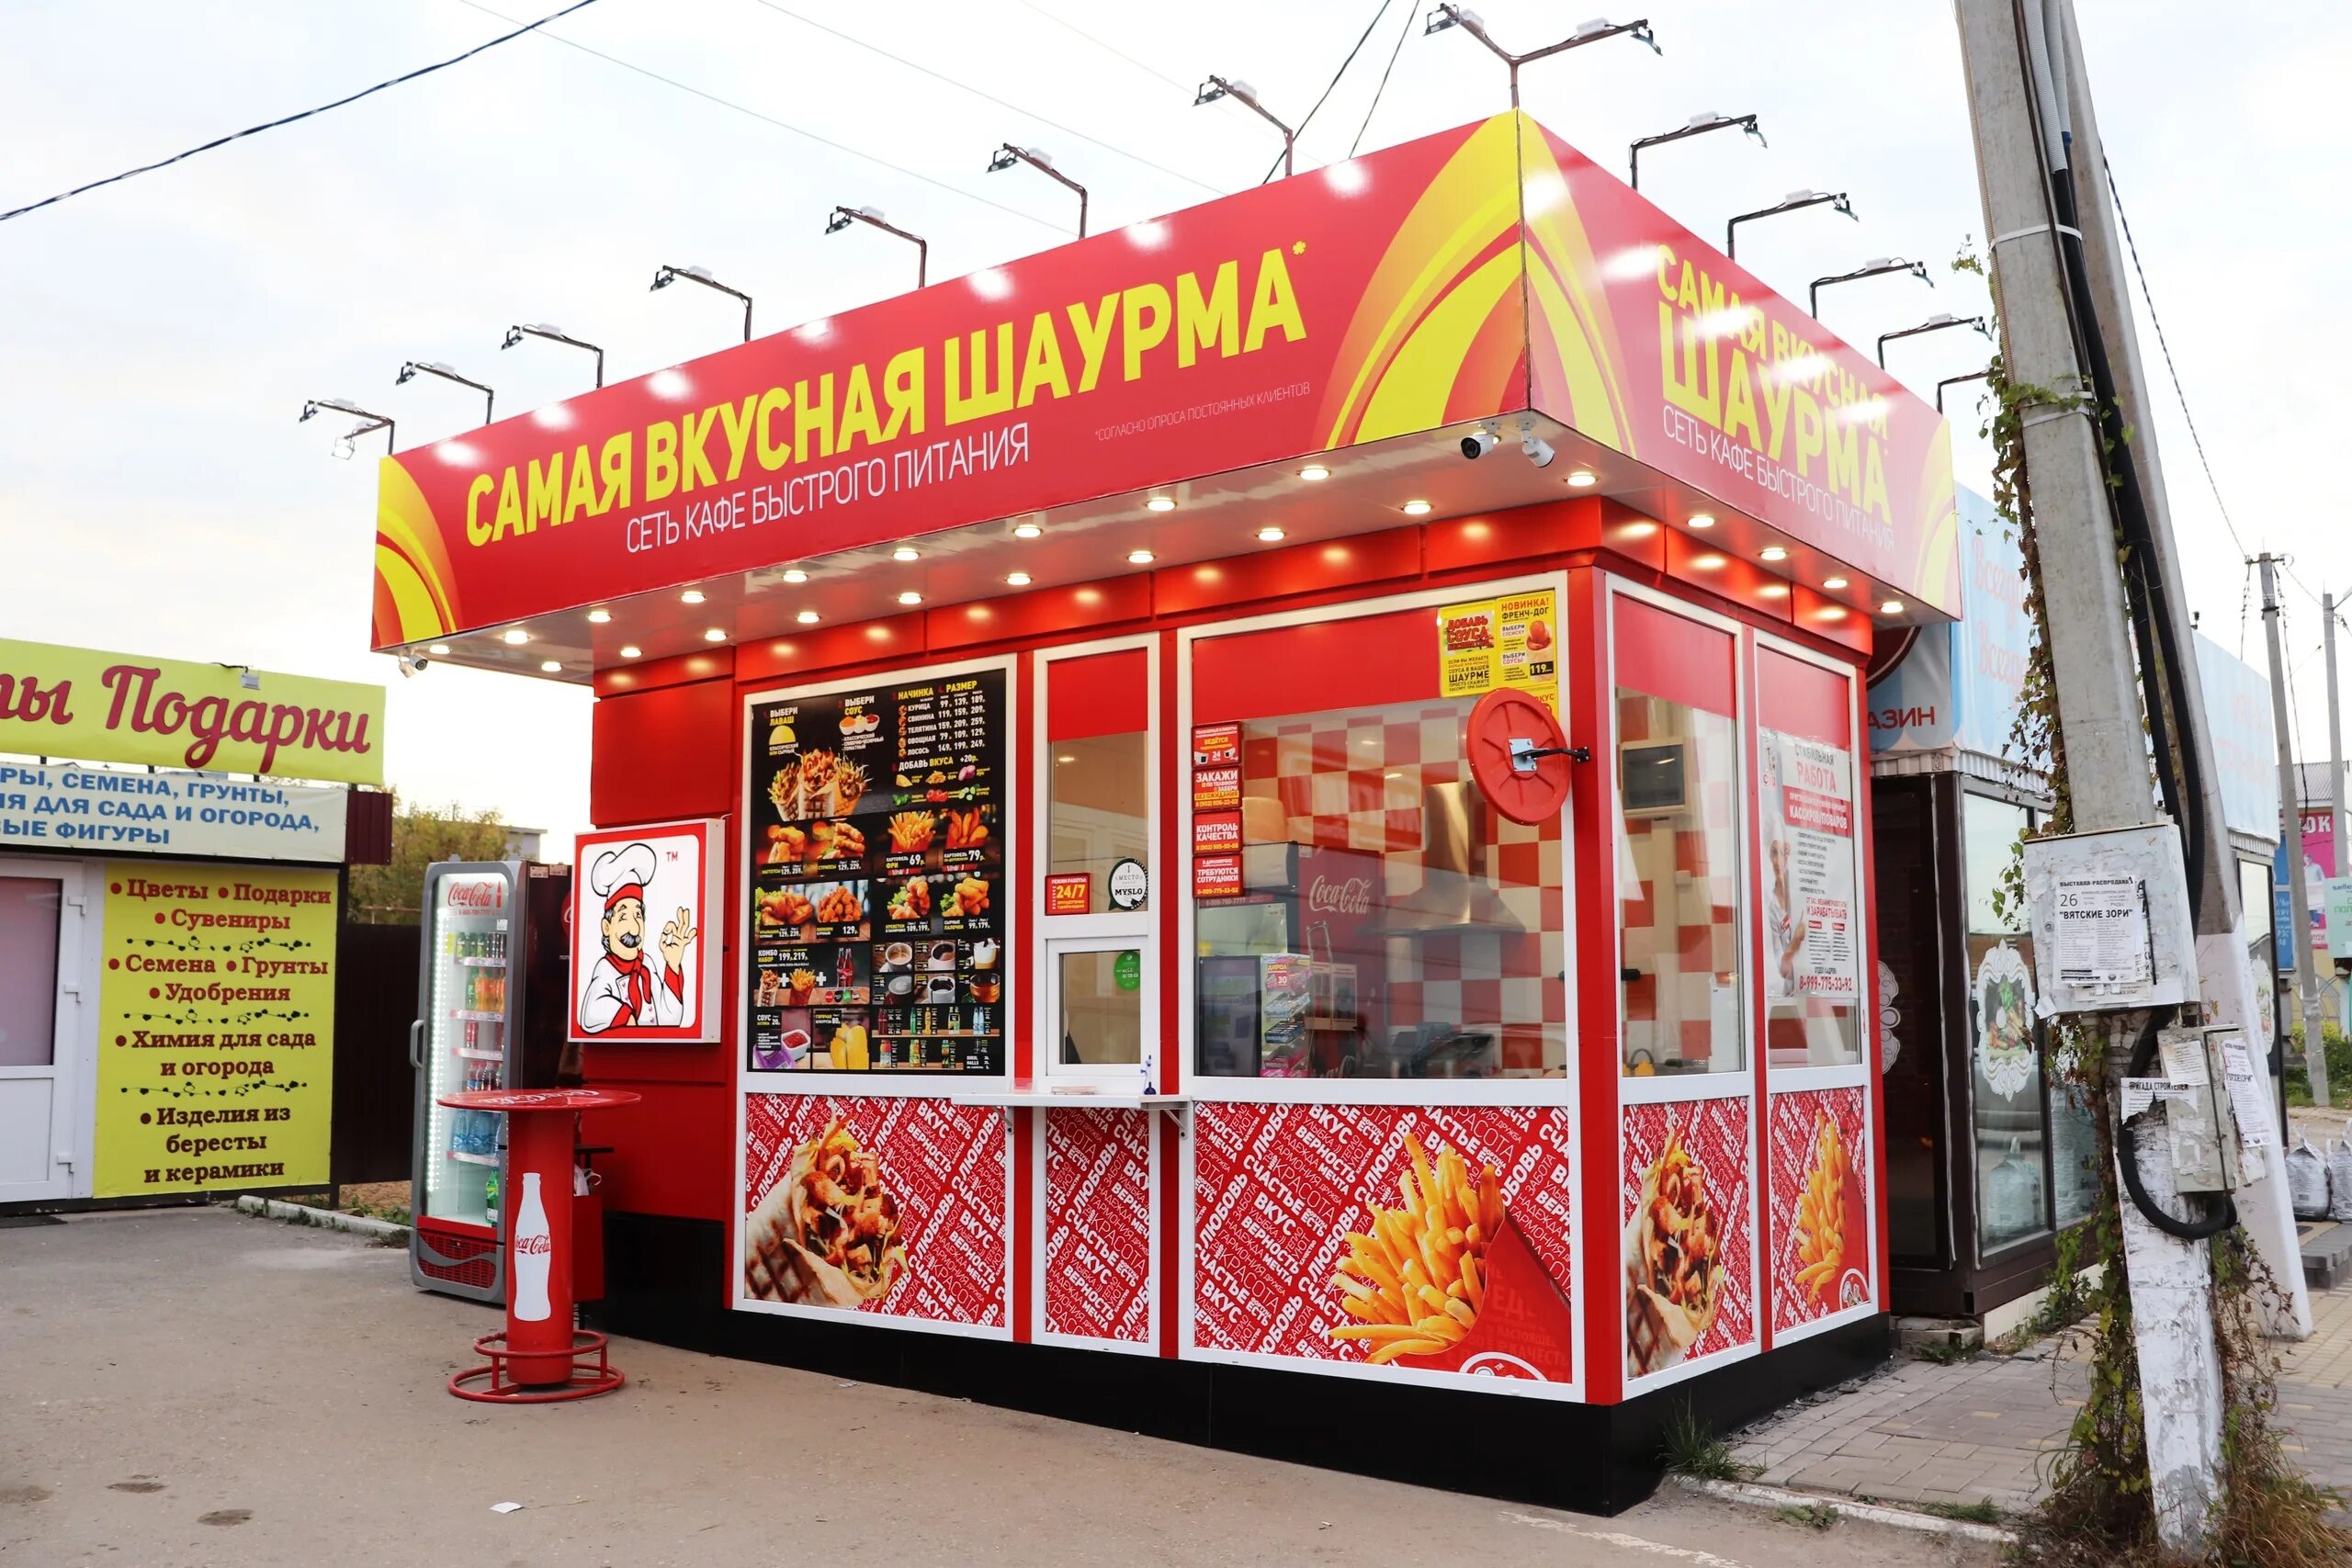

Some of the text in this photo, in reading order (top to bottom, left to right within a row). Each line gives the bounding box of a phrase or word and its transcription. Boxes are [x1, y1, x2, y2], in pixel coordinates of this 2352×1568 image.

[1148, 411, 1186, 431] ОПРОСА
[1187, 395, 1256, 421] ПОСТОЯННЫХ
[1256, 381, 1311, 405] КЛИЕНТОВ
[1658, 300, 1893, 525] ШАУРМА
[467, 431, 632, 547] САМАЯ
[646, 346, 925, 502] ВКУСНАЯ
[627, 422, 1029, 553] СЕТЬ КАФЕ БЫСТРОГО ПИТАНИЯ
[1662, 404, 1895, 550] СЕТЬ КАФЕ БЫСТРОГО ПИТАНИЯ
[1501, 597, 1549, 611] НОВИНКА!
[1501, 607, 1549, 620] ФРЕНЧ-ДОГ
[1447, 626, 1488, 643] СОУСА
[898, 681, 978, 700] НАЧИНКА РАЗМЕР
[1448, 670, 1489, 682] ШАУРМЕ
[770, 706, 798, 718] ВЫБЕРИ
[845, 695, 875, 707] ВЫБЕРИ
[845, 706, 863, 716] СОУС
[908, 703, 931, 712] КУРИЦА
[908, 713, 934, 723] СВИНИНА
[101, 664, 370, 773] Подарки
[770, 716, 795, 727] ЛАВАШ
[908, 724, 937, 734] ТЕЛЯТИНА
[899, 759, 928, 772] ДОБАВЬ
[929, 757, 954, 767] ВКУСА
[907, 747, 930, 756] ЛОСОСЬ
[62, 773, 179, 799] СЕМЕНА,
[187, 783, 289, 807] ГРУНТЫ,
[1196, 770, 1238, 783] ЗАКАЖИ
[1797, 761, 1837, 793] РАБОТА
[33, 795, 89, 815] ДЛЯ
[97, 800, 167, 821] САДА
[175, 806, 192, 821] И
[199, 808, 320, 833] ОГОРОДА,
[1196, 823, 1238, 833] КОНТРОЛЬ
[0, 818, 170, 845] ЫЕ ФИГУРЫ
[1196, 831, 1238, 842] КАЧЕСТВА
[1197, 867, 1238, 876] ТРЕБУЮТСЯ
[1197, 874, 1238, 884] СОТРУДНИКИ
[127, 878, 332, 908] Цветы Подарки
[447, 881, 493, 908] Coca-Cola
[1056, 884, 1086, 899] 24/7
[1114, 887, 1143, 896] MYSLO
[1308, 874, 1372, 915] Coca-Cola
[2060, 893, 2078, 907] 26
[171, 908, 290, 932] Сувениры
[125, 953, 328, 978] Семена Грунты
[165, 983, 290, 1005] Удобрения
[1799, 976, 1852, 991] 8-999-775-33-92
[131, 1031, 316, 1050] Химия для сада
[161, 1059, 274, 1077] и огорода
[156, 1106, 291, 1125] Изделия из
[917, 1100, 950, 1139] ВКУС
[1308, 1104, 1352, 1145] ВКУС
[1711, 1105, 1741, 1157] ВЕРНОСТЬ
[166, 1134, 266, 1155] бересты
[907, 1122, 952, 1173] ВЕРНОСТЬ
[958, 1111, 1000, 1181] ЛЮБОВЬ
[1279, 1128, 1319, 1168] НАДЕЖДА
[1295, 1125, 1356, 1183] ВЕРНОСТЬ
[1363, 1111, 1418, 1193] ЛЮБОВЬ
[144, 1161, 285, 1184] и керамики
[889, 1151, 936, 1207] КРАСОТА
[922, 1154, 947, 1183] МЕЧТА
[1073, 1142, 1118, 1214] ЛЮБОВЬ
[1103, 1151, 1127, 1187] ЗАБОТА
[1272, 1140, 1322, 1187] ГАРМОНИЯ
[1525, 1154, 1556, 1197] ЗАБОТА
[1233, 1182, 1260, 1222] ЗАБОТА
[1243, 1154, 1306, 1216] СЧАСТЬЕ
[1272, 1158, 1335, 1224] КРАСОТА
[951, 1176, 1001, 1231] СЧАСТЬЕ
[1199, 1173, 1249, 1249] ЛЮБОВЬ
[1253, 1191, 1296, 1235] ВКУС
[915, 1192, 956, 1261] ЛЮБОВЬ
[1065, 1208, 1119, 1267] СЧАСТЬЕ
[1307, 1204, 1360, 1283] ЛЮБОВЬ
[515, 1234, 551, 1255] oca-Cola
[936, 1232, 967, 1268] НАДЕЖДА
[949, 1231, 996, 1284] ВЕРНОСТЬ
[1091, 1213, 1146, 1275] КРАСОТА
[1240, 1215, 1300, 1275] ВЕРНОСТЬ
[1074, 1243, 1112, 1284] ВКУС
[1261, 1253, 1294, 1287] МЕЧТА
[908, 1254, 956, 1310] СЧАСТЬЕ
[1063, 1264, 1114, 1321] ВЕРНОСТЬ
[1082, 1300, 1109, 1332] МЕЧТА
[1722, 1293, 1744, 1330] ВКУС
